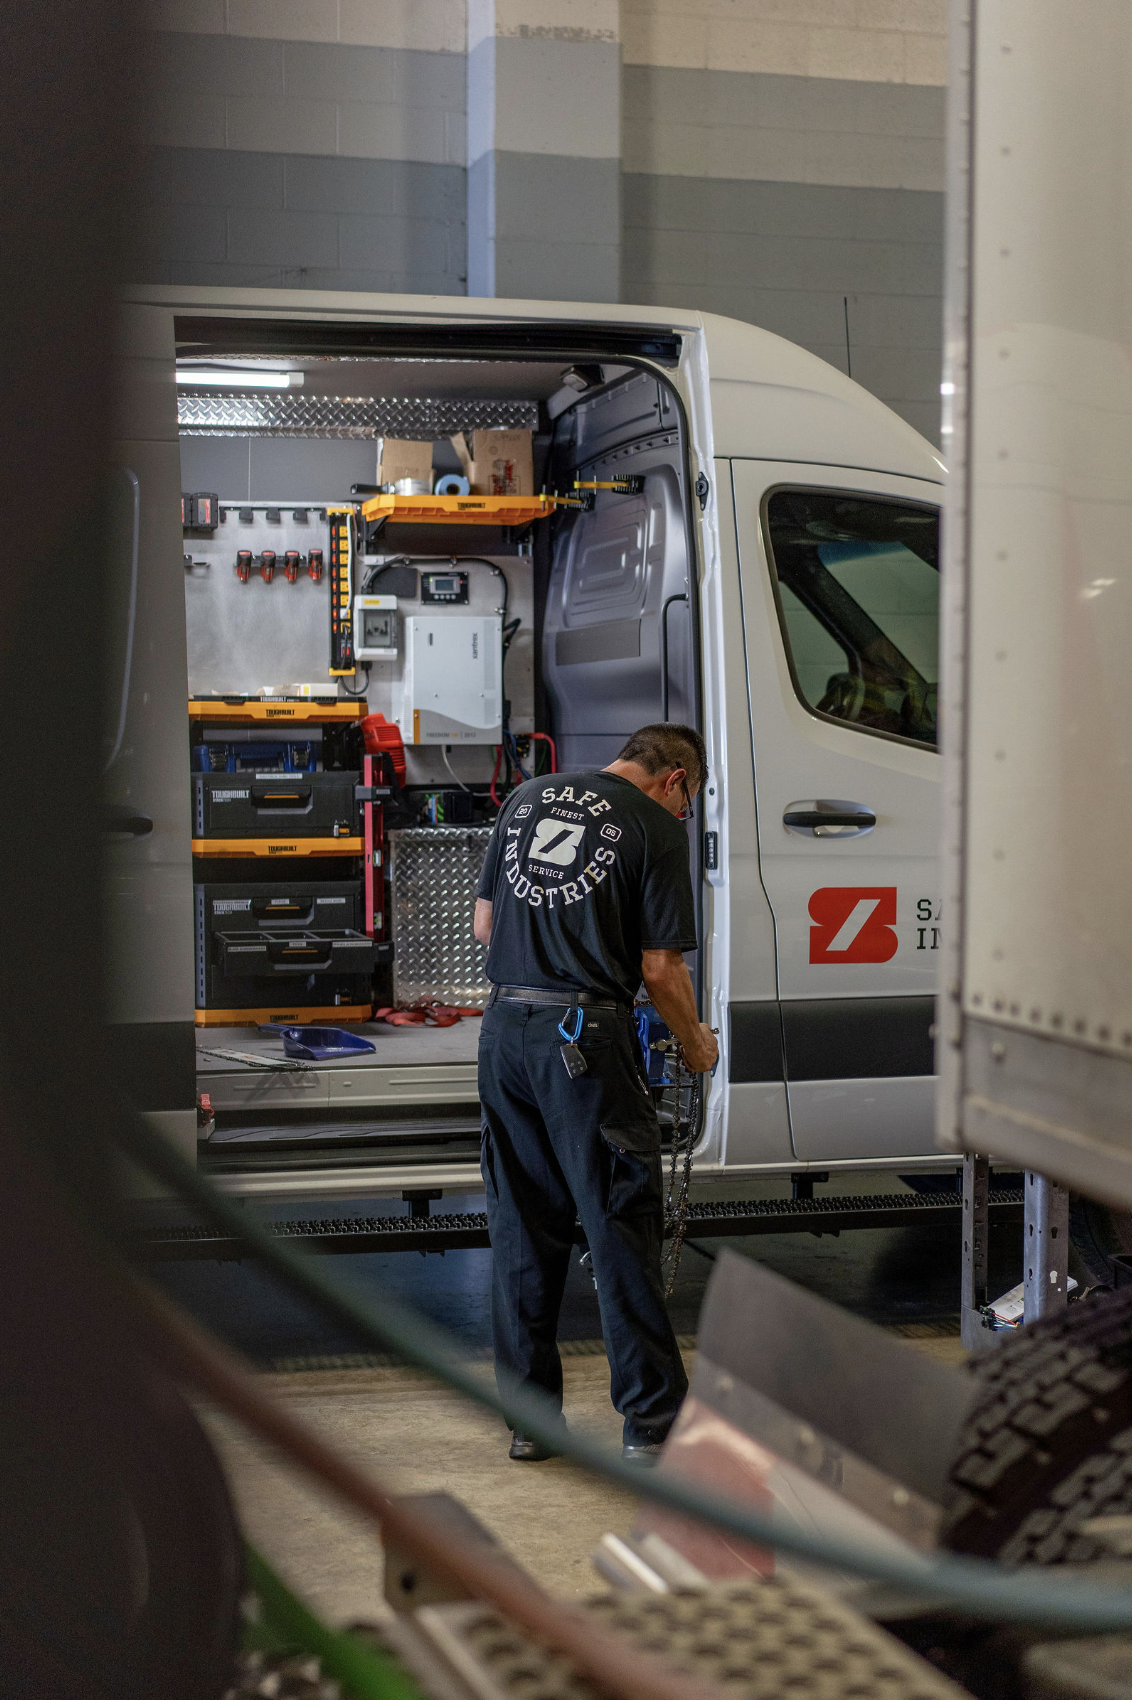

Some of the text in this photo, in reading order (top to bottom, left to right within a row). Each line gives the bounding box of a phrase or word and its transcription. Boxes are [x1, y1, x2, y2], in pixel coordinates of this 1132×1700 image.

[211, 790, 250, 799] TOUGHBUILT
[541, 786, 612, 817] SAFE
[550, 807, 585, 820] FINEST
[505, 827, 616, 909] INDUSTRIES
[528, 864, 564, 880] SERVICE
